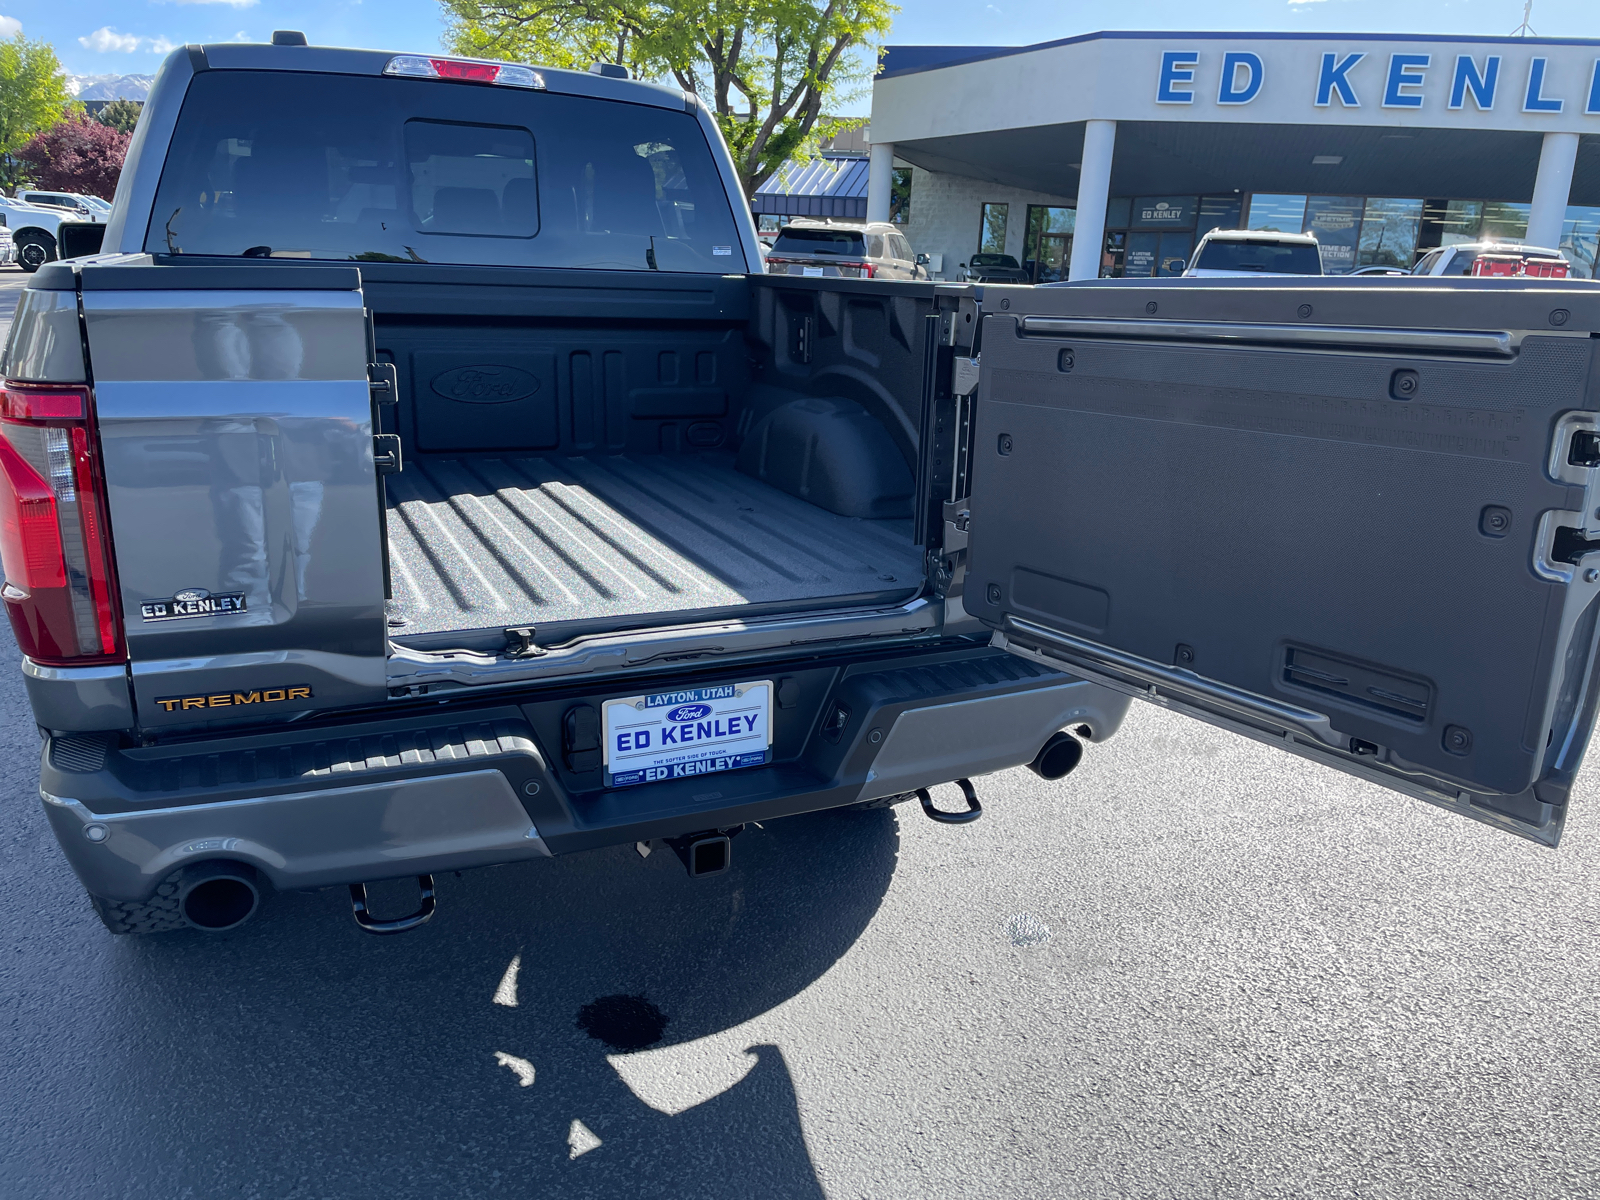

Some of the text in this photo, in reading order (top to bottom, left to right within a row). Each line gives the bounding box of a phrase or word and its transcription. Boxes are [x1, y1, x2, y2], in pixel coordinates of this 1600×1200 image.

[1156, 50, 1265, 104] ED
[452, 370, 519, 396] Ford
[142, 597, 243, 617] ED KENLEY
[157, 687, 311, 711] TREMOR
[647, 688, 733, 706] LAYTON, UTAH
[676, 707, 702, 720] Ford
[617, 714, 758, 751] ED KENLEY
[646, 757, 735, 781] ED KENLEY
